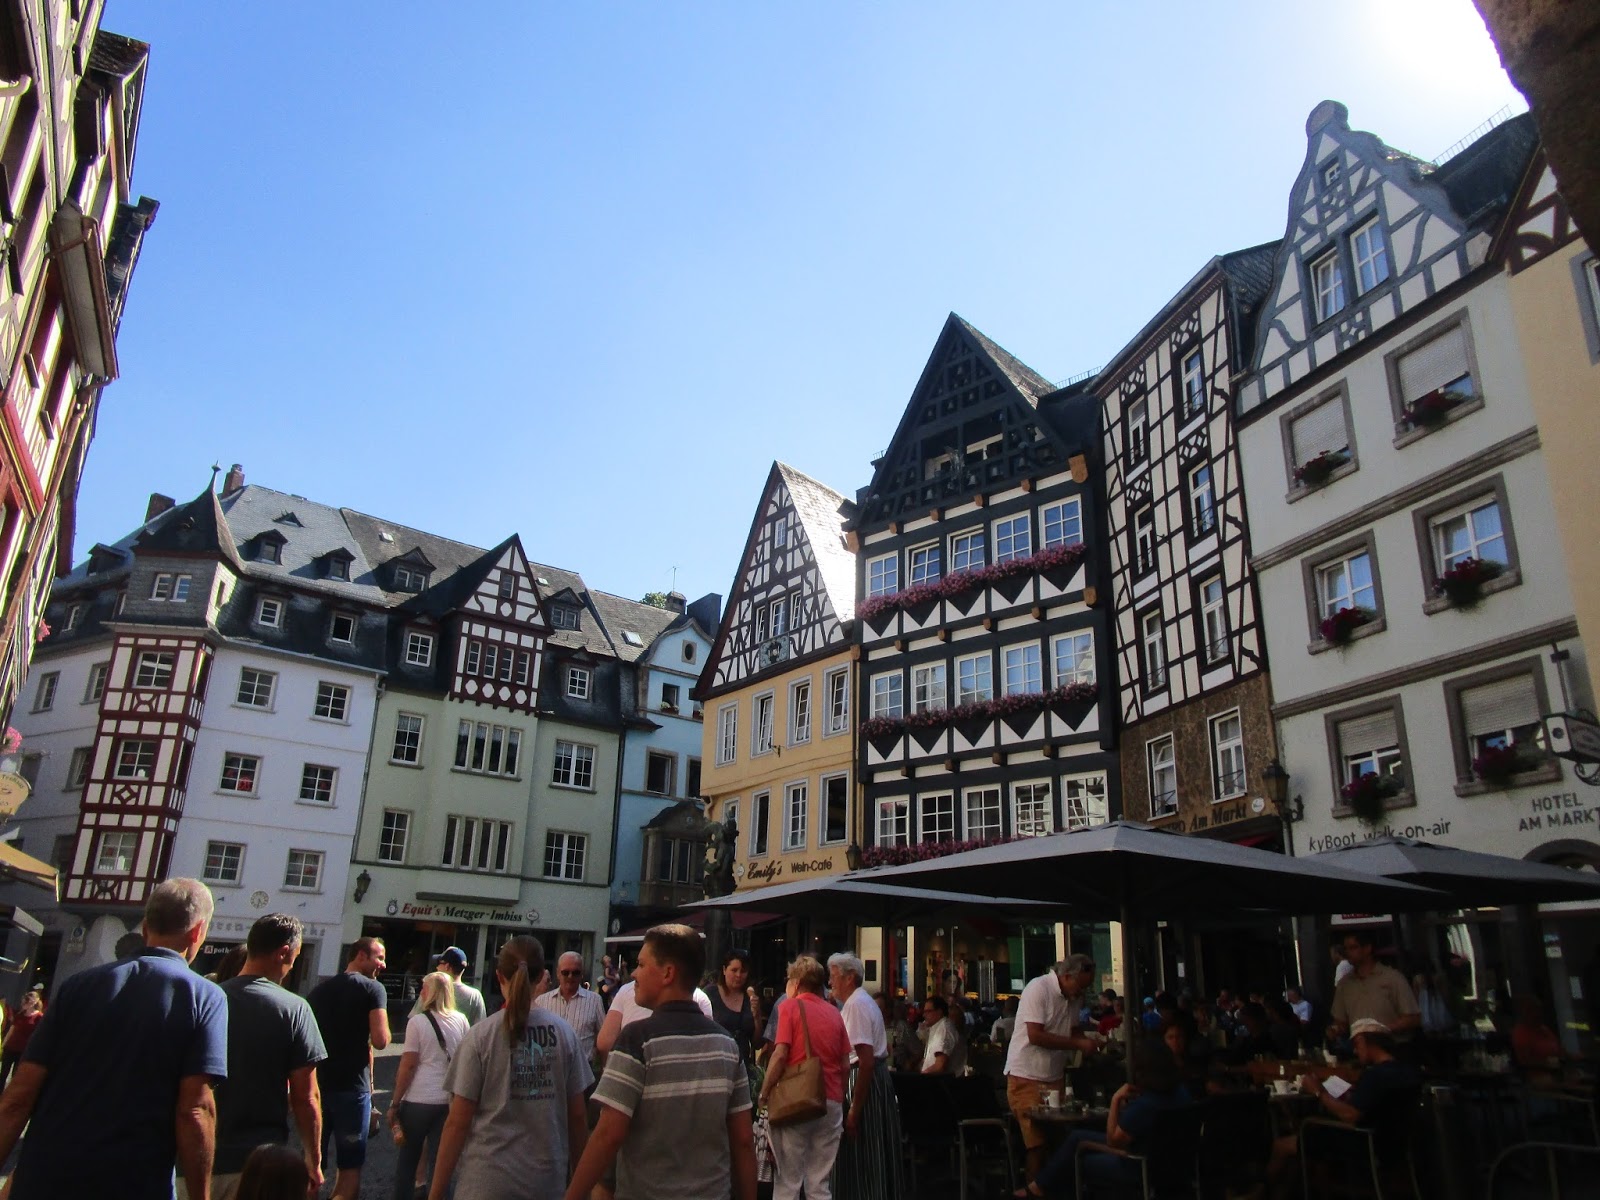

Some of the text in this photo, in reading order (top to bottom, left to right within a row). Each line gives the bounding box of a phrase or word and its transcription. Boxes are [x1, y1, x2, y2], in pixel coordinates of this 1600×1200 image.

[1532, 792, 1583, 812] HOTEL
[1189, 814, 1208, 831] Am
[1211, 802, 1247, 826] Markt
[1519, 816, 1542, 832] AM
[1309, 832, 1356, 852] kyBoot
[747, 860, 782, 882] Emily's
[443, 906, 523, 922] Metzger-Imbiss
